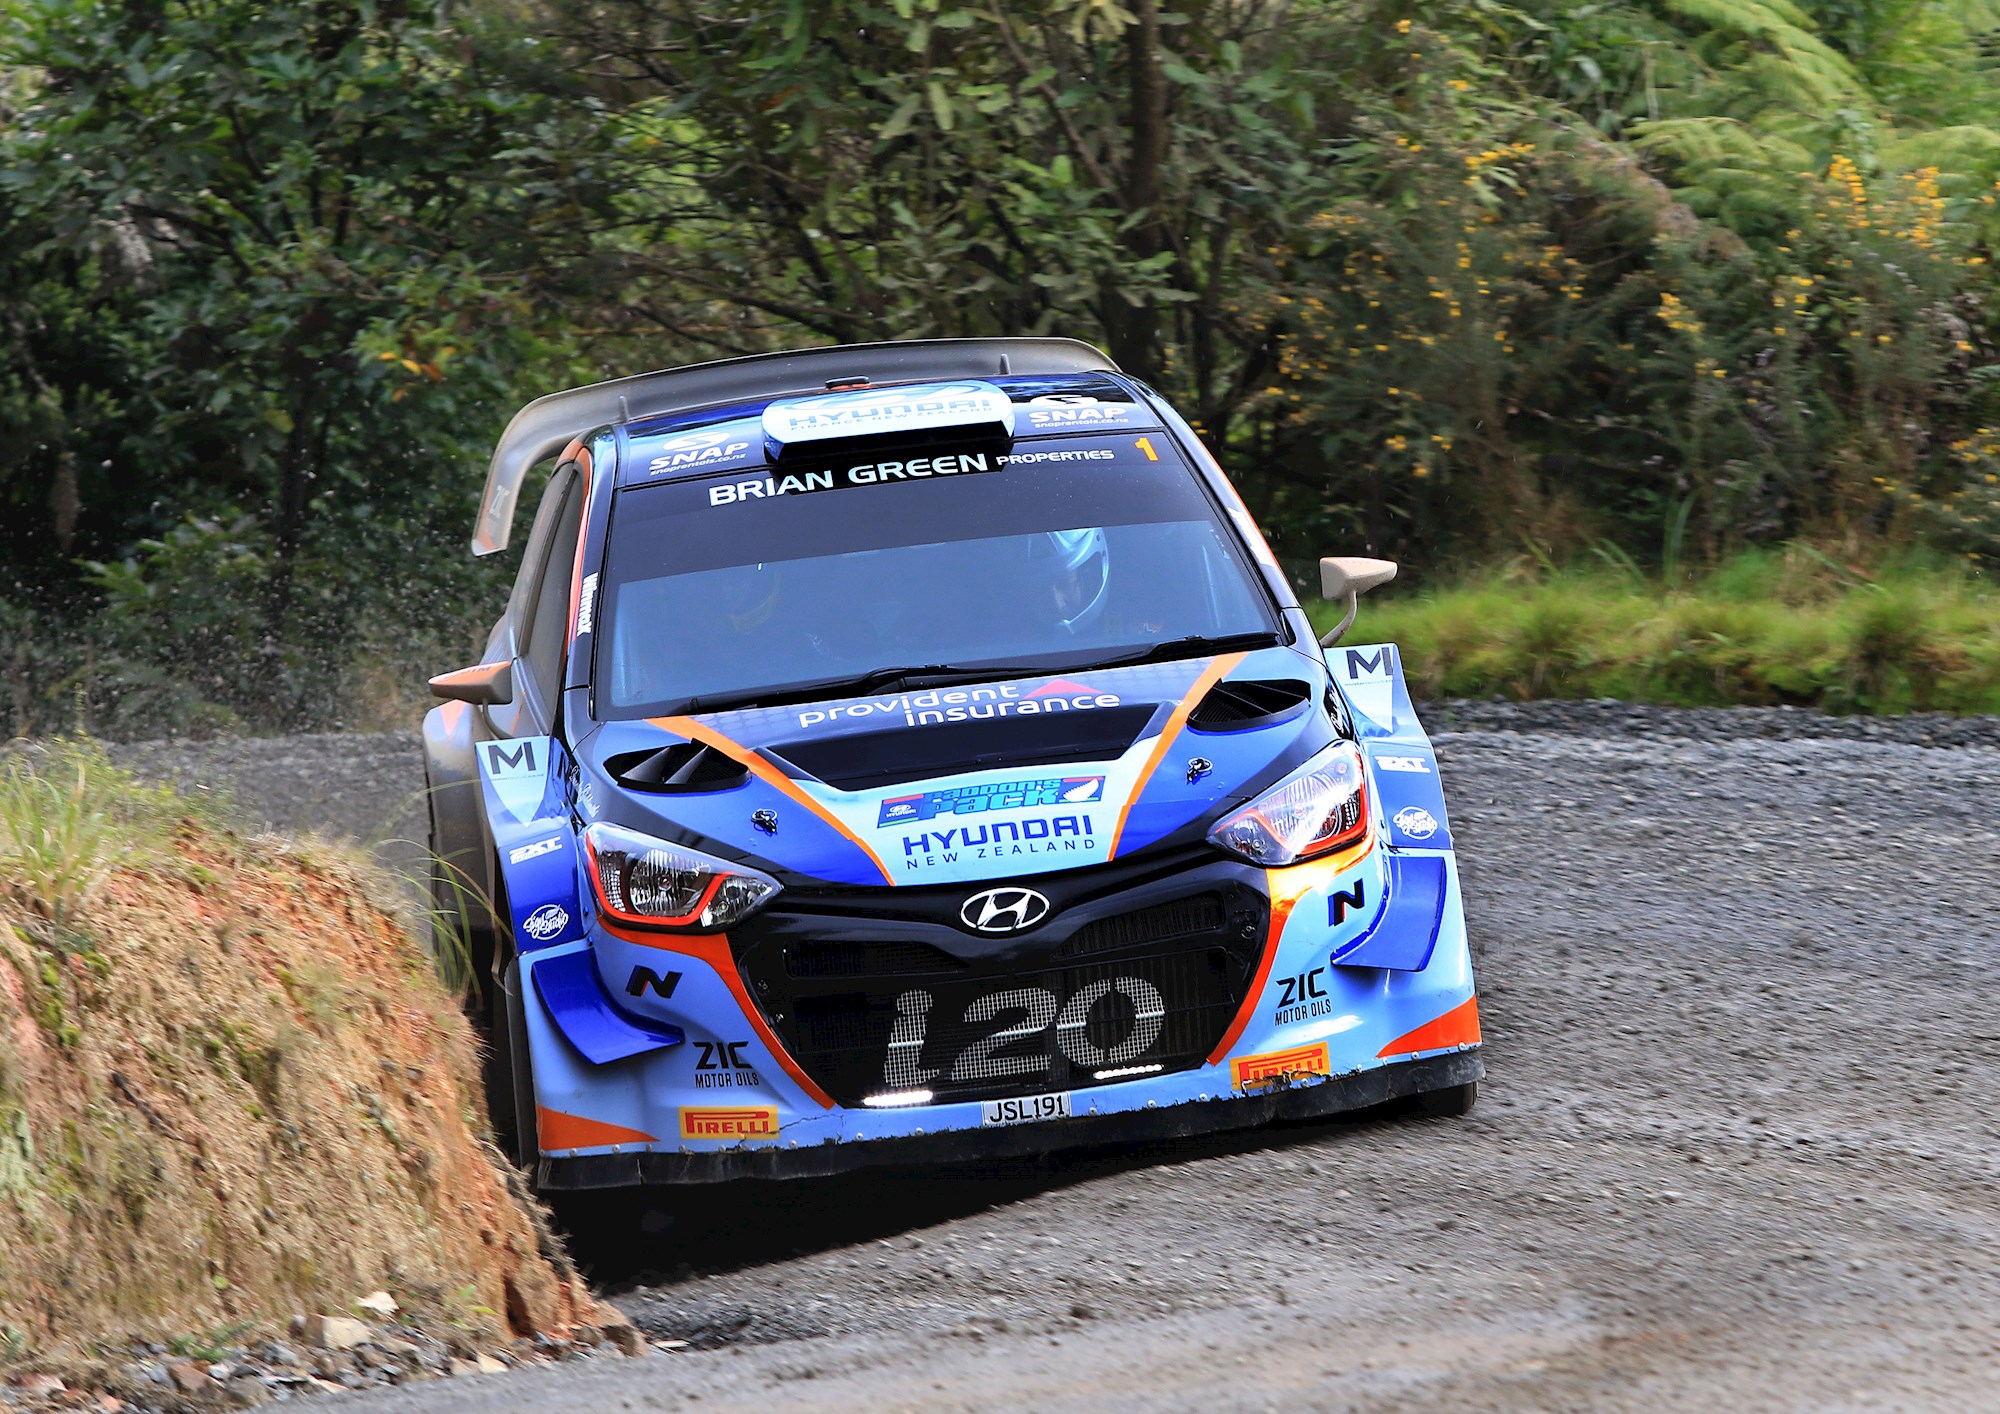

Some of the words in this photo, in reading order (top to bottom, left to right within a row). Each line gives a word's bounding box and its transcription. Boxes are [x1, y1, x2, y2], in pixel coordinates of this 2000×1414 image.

[789, 399, 991, 427] HYUNDAI
[1029, 407, 1126, 423] SNAP
[1034, 417, 1129, 429] snaprentals.co.nz
[648, 442, 749, 471] SNAP
[1134, 437, 1159, 462] 1
[649, 453, 746, 476] snaprentals.co.nz
[708, 469, 834, 507] BRIAN
[847, 453, 989, 484] GREEN
[995, 449, 1115, 466] PROPERTIES
[799, 684, 1021, 729] provident
[904, 692, 1121, 727] insurance
[487, 741, 536, 775] M
[902, 814, 1093, 856] HYUNDAI
[906, 852, 958, 870] NEW
[977, 839, 1096, 859] ZEALAND
[1327, 877, 1365, 928] N
[625, 964, 683, 999] N
[1275, 966, 1329, 1009] ZIC
[1274, 1004, 1308, 1027] MOTOR
[1310, 998, 1332, 1018] OILS
[692, 1041, 754, 1070] ZIC
[694, 1072, 733, 1089] MOTOR
[735, 1071, 760, 1087] OILS
[684, 1111, 770, 1134] PIRELLI
[989, 1095, 1065, 1123] JSL191
